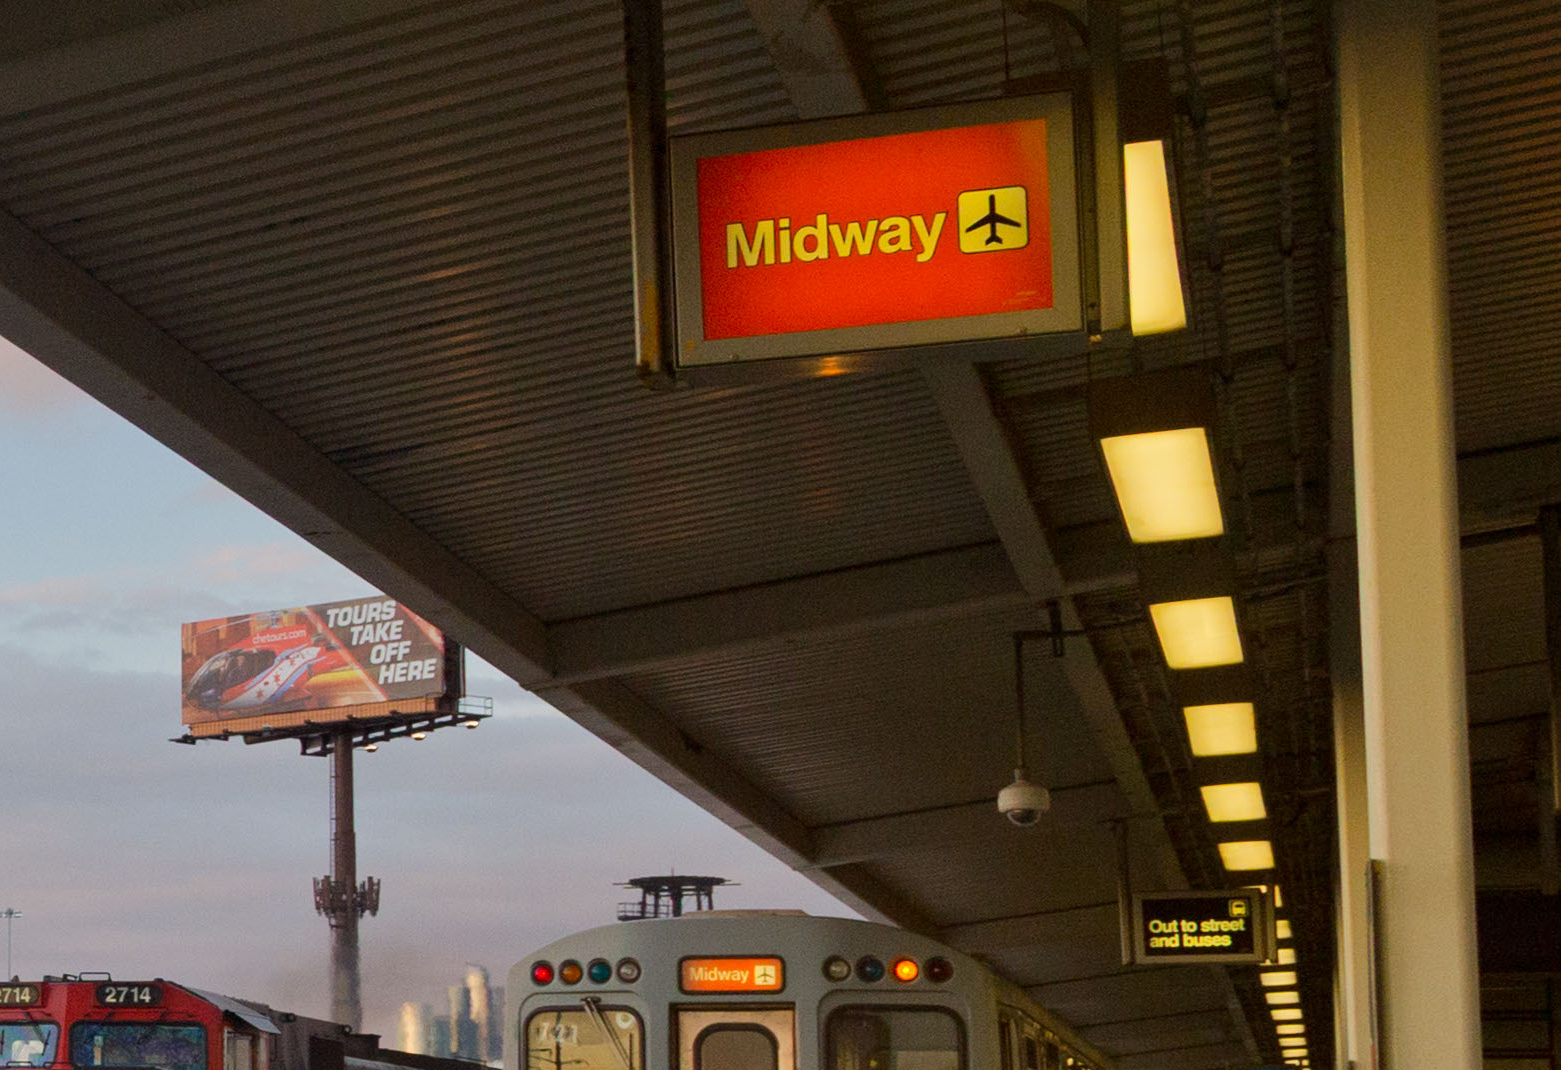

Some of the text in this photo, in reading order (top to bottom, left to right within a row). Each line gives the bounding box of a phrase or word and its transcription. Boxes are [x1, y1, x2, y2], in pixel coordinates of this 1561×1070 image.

[726, 212, 947, 269] Midway
[326, 600, 396, 629] TOURS
[350, 619, 404, 646] TAKE
[370, 640, 412, 664] OFF
[379, 658, 437, 685] HERE
[1149, 918, 1245, 933] Out to street
[1149, 933, 1232, 948] and buses
[689, 966, 750, 984] Midway
[105, 986, 152, 1004] 2714
